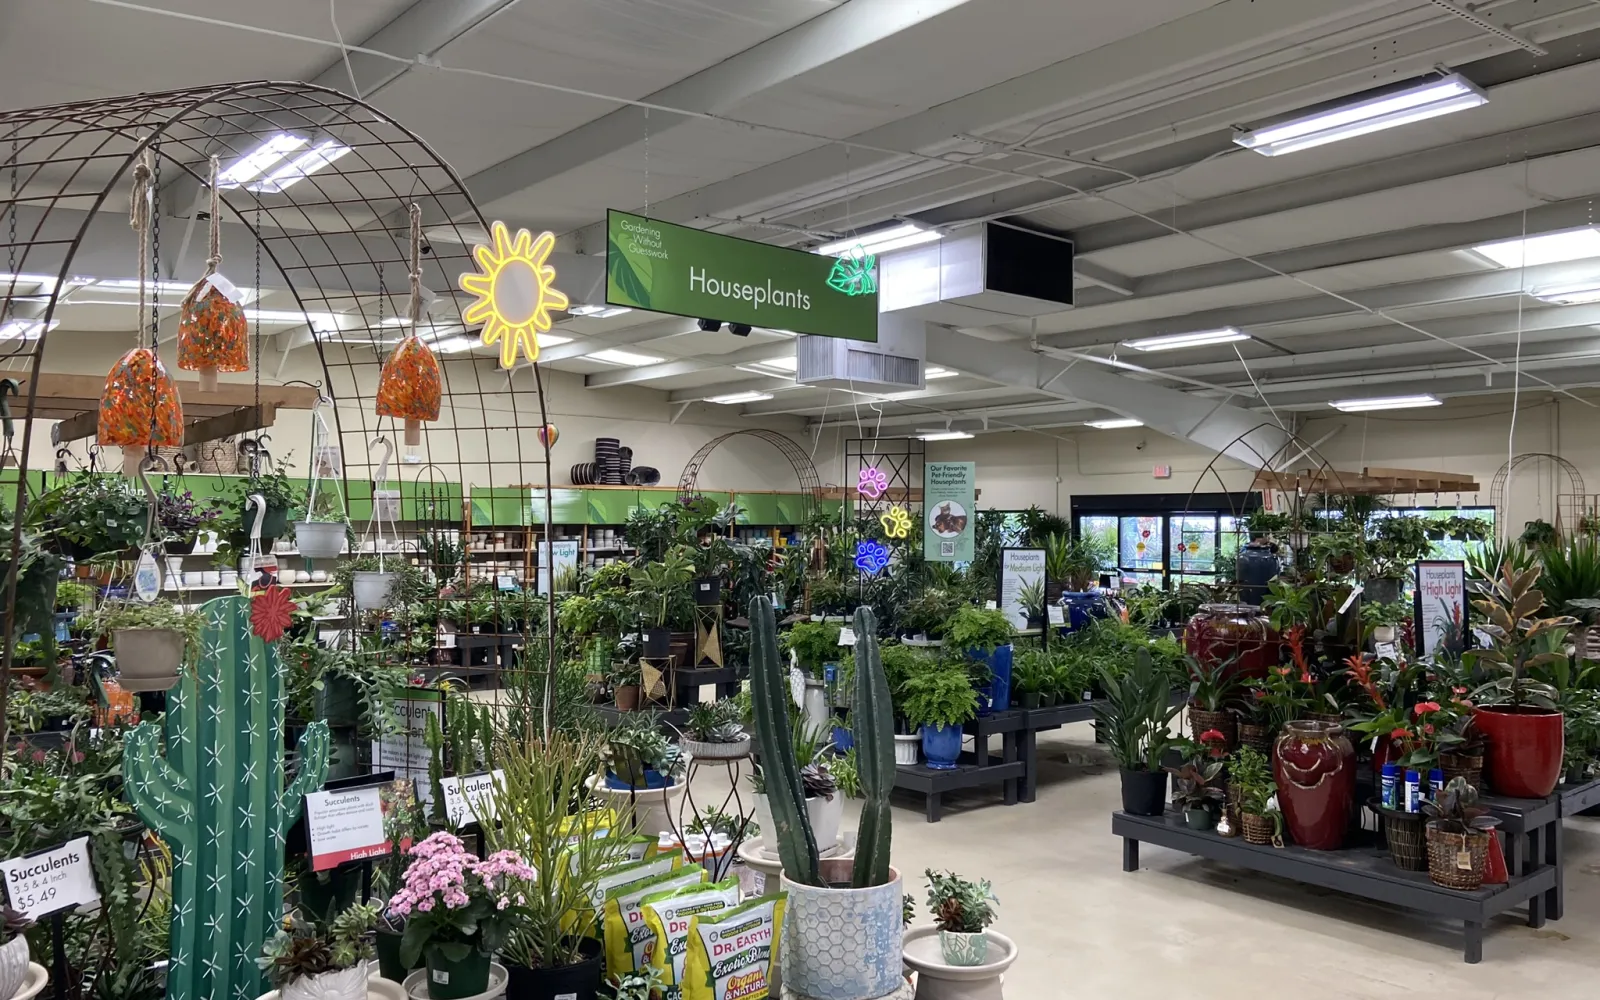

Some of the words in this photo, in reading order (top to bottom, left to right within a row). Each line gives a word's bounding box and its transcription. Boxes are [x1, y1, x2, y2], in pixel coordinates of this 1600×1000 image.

[620, 219, 661, 239] Gardening
[633, 234, 662, 248] Without
[628, 243, 669, 260] Guesswork
[690, 266, 811, 310] Houseplants
[931, 471, 966, 479] Pet-Friendly
[943, 464, 967, 472] Favorite
[930, 478, 967, 486] Houseplants
[559, 548, 575, 558] Light
[1010, 552, 1040, 562] Houseplants
[1010, 562, 1032, 572] Medium
[1425, 568, 1456, 579] Houseplants
[1426, 581, 1443, 599] High
[1445, 580, 1462, 599] Light
[324, 795, 360, 807] Succulents
[9, 852, 80, 883] Succulents
[14, 882, 29, 895] 3.5
[32, 879, 39, 889] &
[42, 876, 48, 885] 4
[50, 871, 67, 884] Inch
[18, 887, 57, 910] $5.49
[713, 943, 736, 956] DR.
[736, 928, 771, 949] EARTH
[713, 953, 746, 978] Exotic
[728, 970, 764, 990] Organi
[733, 979, 768, 998] NATURA
